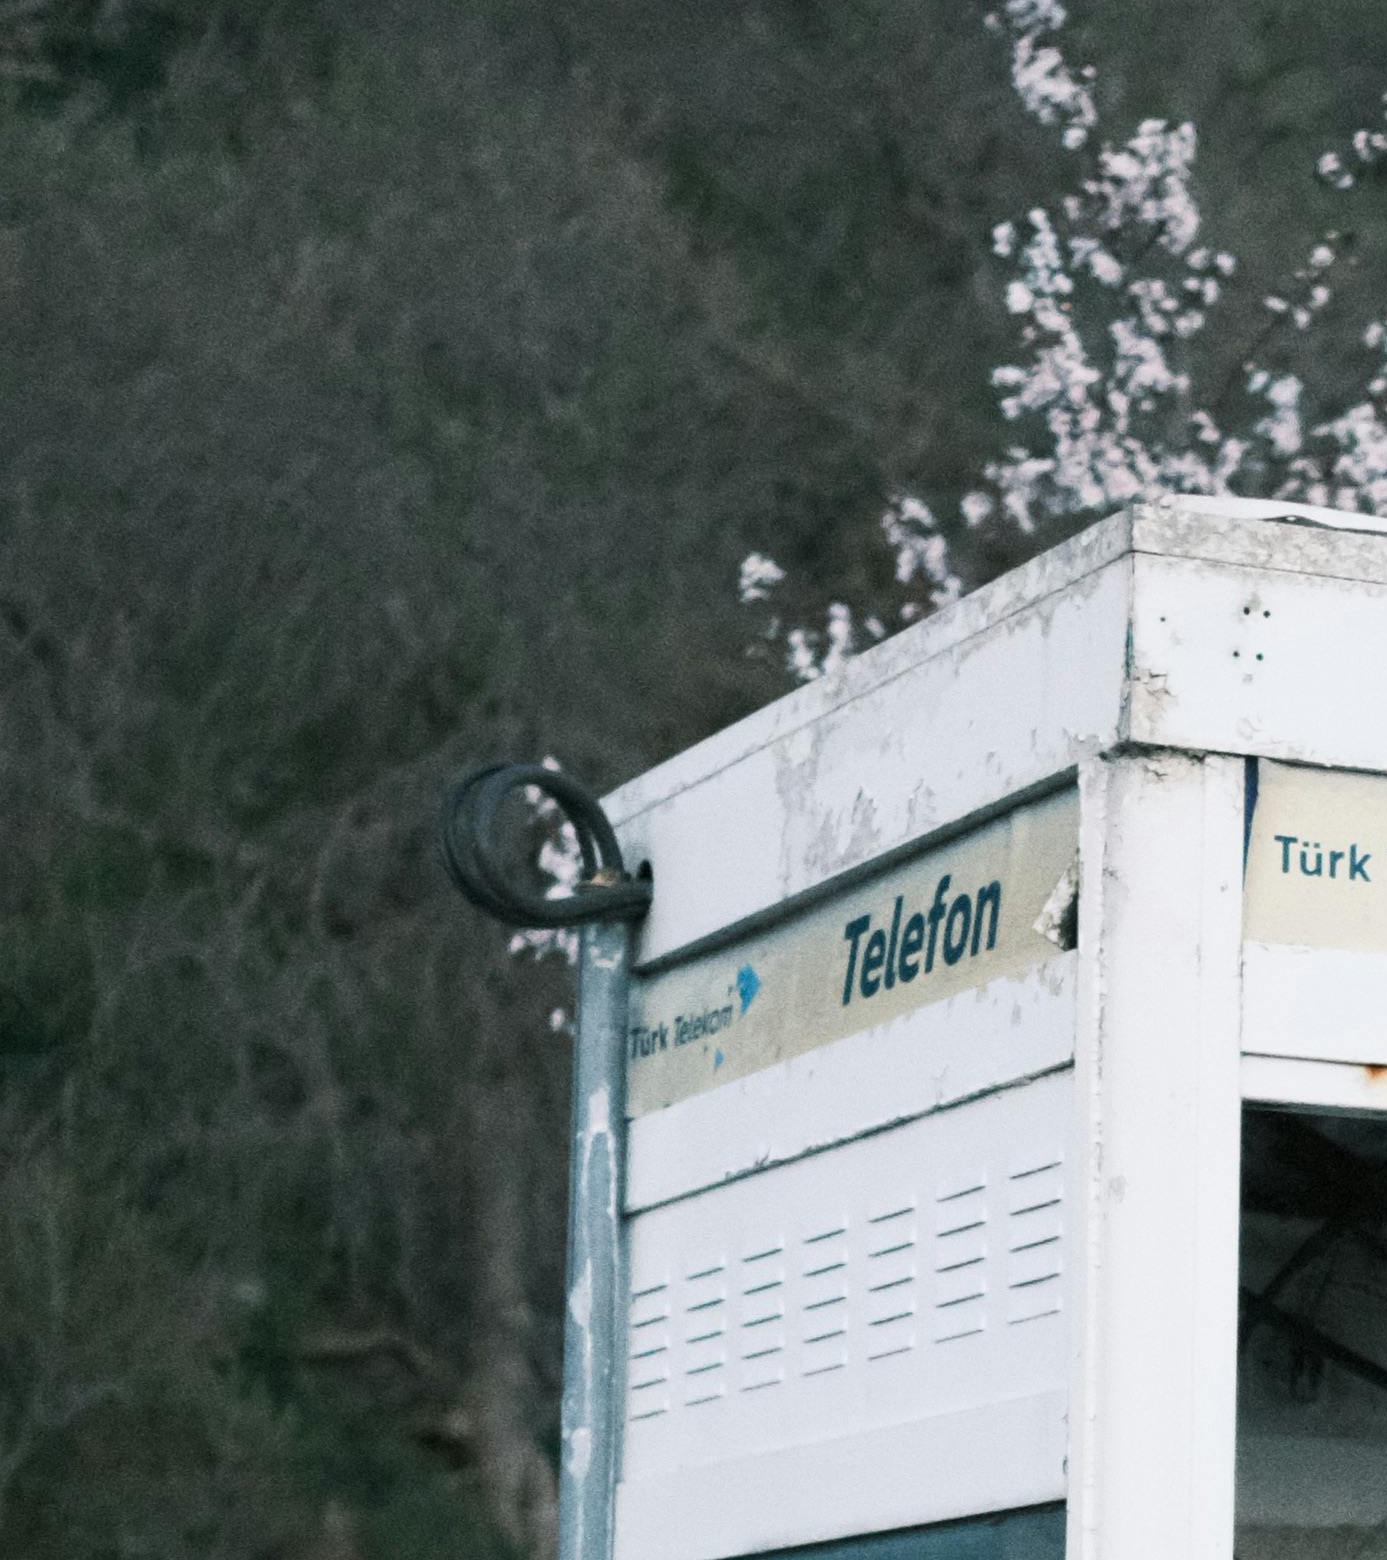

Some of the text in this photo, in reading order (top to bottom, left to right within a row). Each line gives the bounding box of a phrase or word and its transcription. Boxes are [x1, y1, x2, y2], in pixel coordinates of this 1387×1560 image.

[1275, 834, 1370, 883] Türk
[842, 873, 1001, 1006] Telefon
[674, 1003, 734, 1047] Telekom
